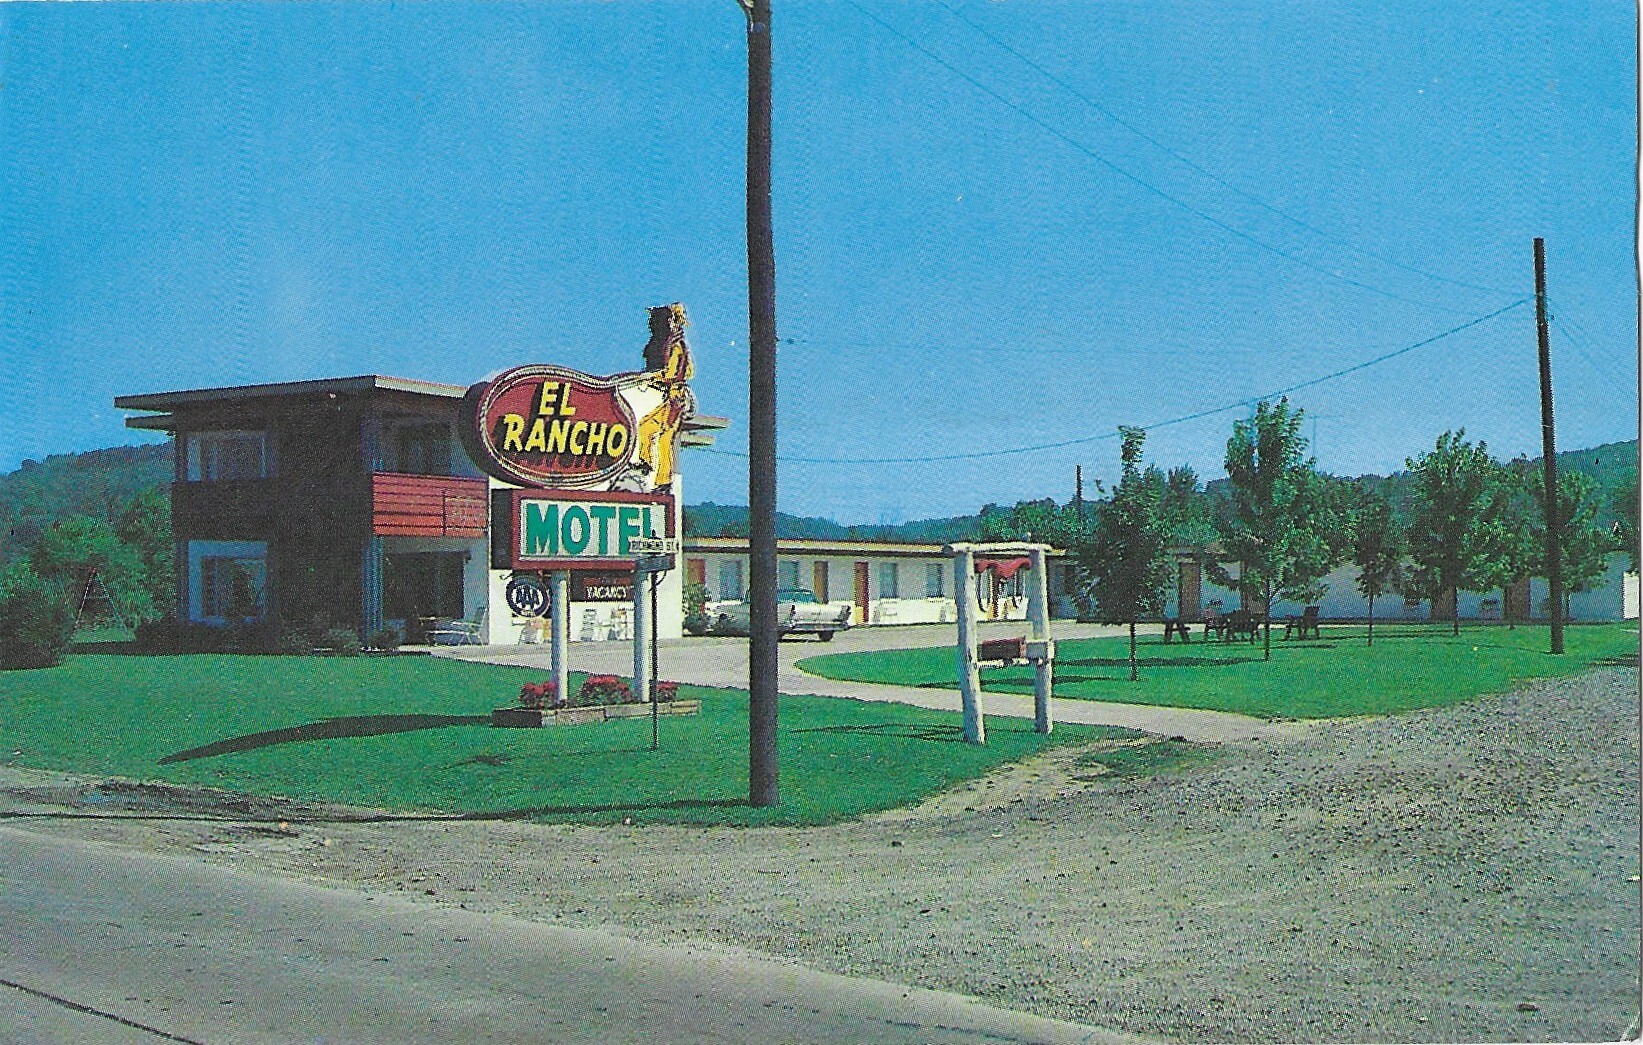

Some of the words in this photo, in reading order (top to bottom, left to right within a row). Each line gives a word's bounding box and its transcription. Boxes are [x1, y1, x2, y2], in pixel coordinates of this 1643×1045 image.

[538, 381, 576, 416] EL
[502, 413, 628, 458] RANCHO
[515, 584, 540, 609] AAA
